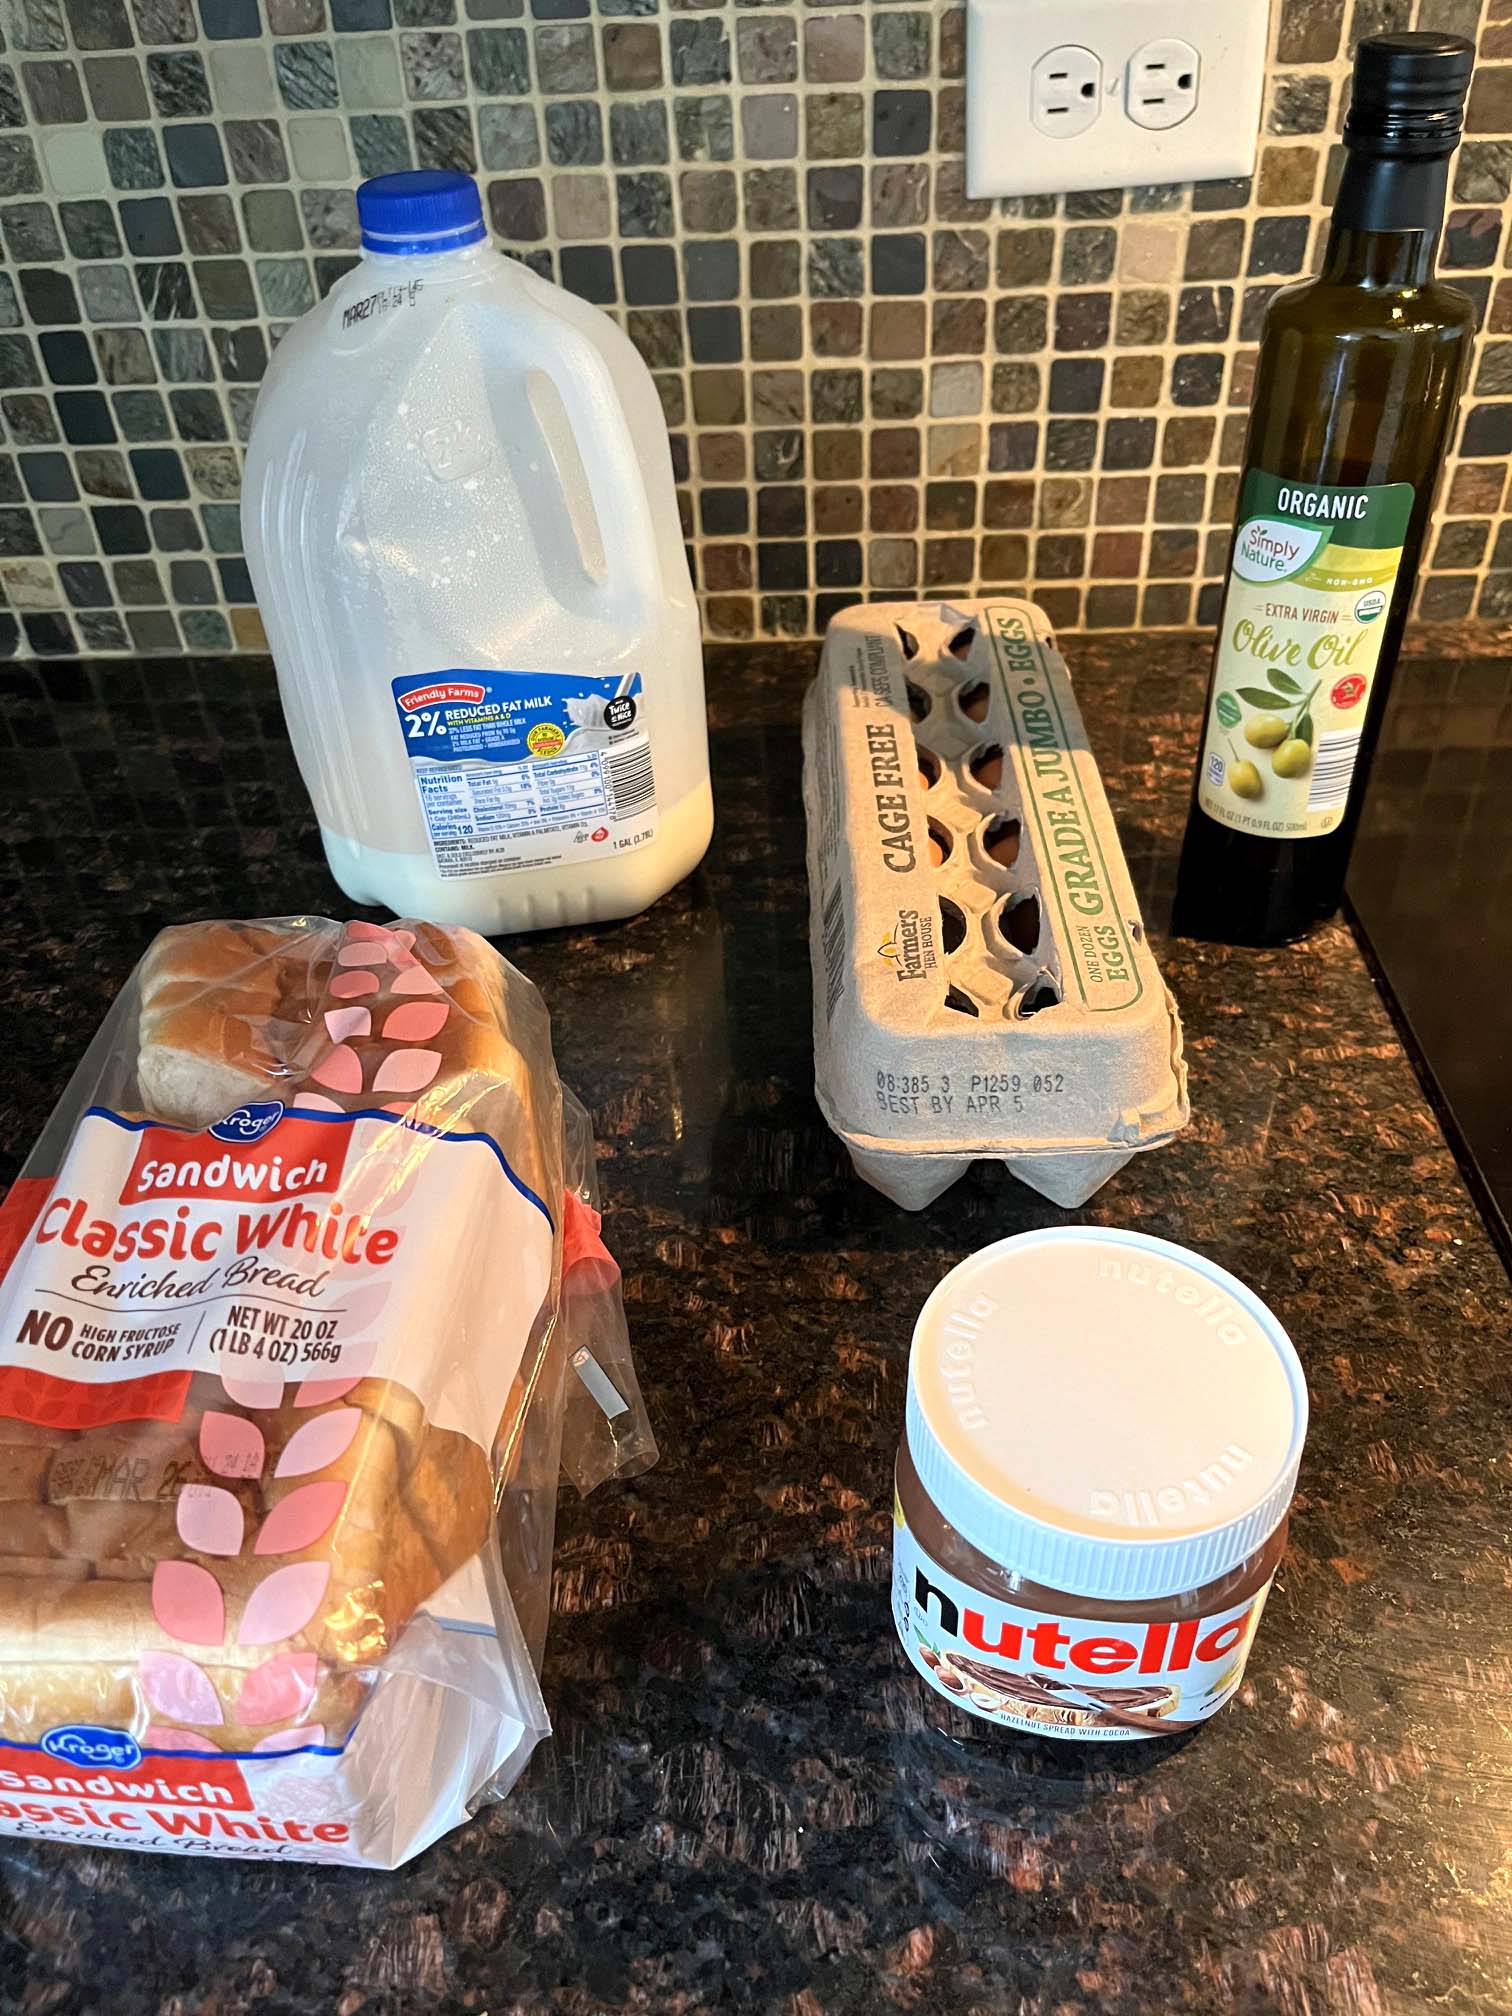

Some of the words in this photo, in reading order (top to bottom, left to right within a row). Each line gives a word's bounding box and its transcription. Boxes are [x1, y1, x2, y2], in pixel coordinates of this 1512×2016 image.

[1278, 487, 1369, 519] ORGANIC
[1240, 543, 1285, 572] Nature
[1249, 528, 1300, 560] Simply
[1265, 603, 1298, 621] EXTRA
[1302, 608, 1339, 624] VIRGIN
[997, 618, 1037, 672] EGGS
[1232, 618, 1302, 666] Olive
[1306, 629, 1369, 670] Oil
[405, 687, 446, 707] Friendly
[448, 688, 480, 699] Farms
[445, 704, 500, 720] REDUCED
[503, 700, 522, 713] FAT
[524, 696, 552, 710] MILK
[404, 711, 447, 738] 2%
[447, 718, 464, 726] WITH
[464, 715, 494, 725] VITAMINS
[1017, 690, 1069, 782] JUMBO
[866, 724, 904, 788] FREE
[420, 775, 462, 785] Nutrition
[422, 785, 448, 793] Facts
[1042, 786, 1074, 807] A
[458, 825, 474, 835] 120
[613, 841, 617, 849] 1
[619, 838, 632, 848] GAL
[876, 793, 917, 874] CAGE
[1047, 811, 1104, 916] GRADE
[920, 916, 933, 945] HOUSE
[1077, 925, 1096, 957] DOZEN
[922, 950, 937, 969] HEN
[1094, 923, 1130, 982] EGGS
[1084, 958, 1104, 983] ONE
[941, 1077, 950, 1093] 3
[971, 1074, 1021, 1093] P1259
[1033, 1073, 1065, 1093] 052
[876, 1090, 919, 1115] BEST
[930, 1096, 953, 1113] BY
[966, 1095, 1001, 1113] APR
[1013, 1095, 1024, 1113] 5
[137, 1154, 328, 1193] Sandwich
[35, 1197, 223, 1263] Classic
[235, 1202, 399, 1265] White
[71, 1264, 220, 1300] Enriched
[224, 1256, 330, 1298] Bread
[1099, 1260, 1249, 1346] nutella
[15, 1309, 73, 1351] NO
[80, 1323, 118, 1343] HIGH
[119, 1323, 181, 1343] FRUCTOSE
[227, 1305, 261, 1330] NET
[263, 1311, 290, 1338] WT
[290, 1318, 312, 1340] 20
[315, 1320, 338, 1340] OZ
[72, 1341, 121, 1362] CORN
[122, 1338, 175, 1361] SYRUP
[209, 1328, 227, 1353] (1
[229, 1330, 251, 1355] LB
[253, 1336, 265, 1359] 4
[268, 1340, 298, 1366] OZ)
[300, 1341, 342, 1363] 566g
[939, 1292, 999, 1430] nutella
[1088, 1442, 1256, 1527] nutella
[915, 1565, 1255, 1674] nutella
[1001, 1713, 1040, 1730] HAZELNUT
[1043, 1723, 1076, 1735] SPREAD
[1079, 1728, 1100, 1736] WITH
[49, 1733, 133, 1761] Kroger
[146, 1808, 349, 1843] White
